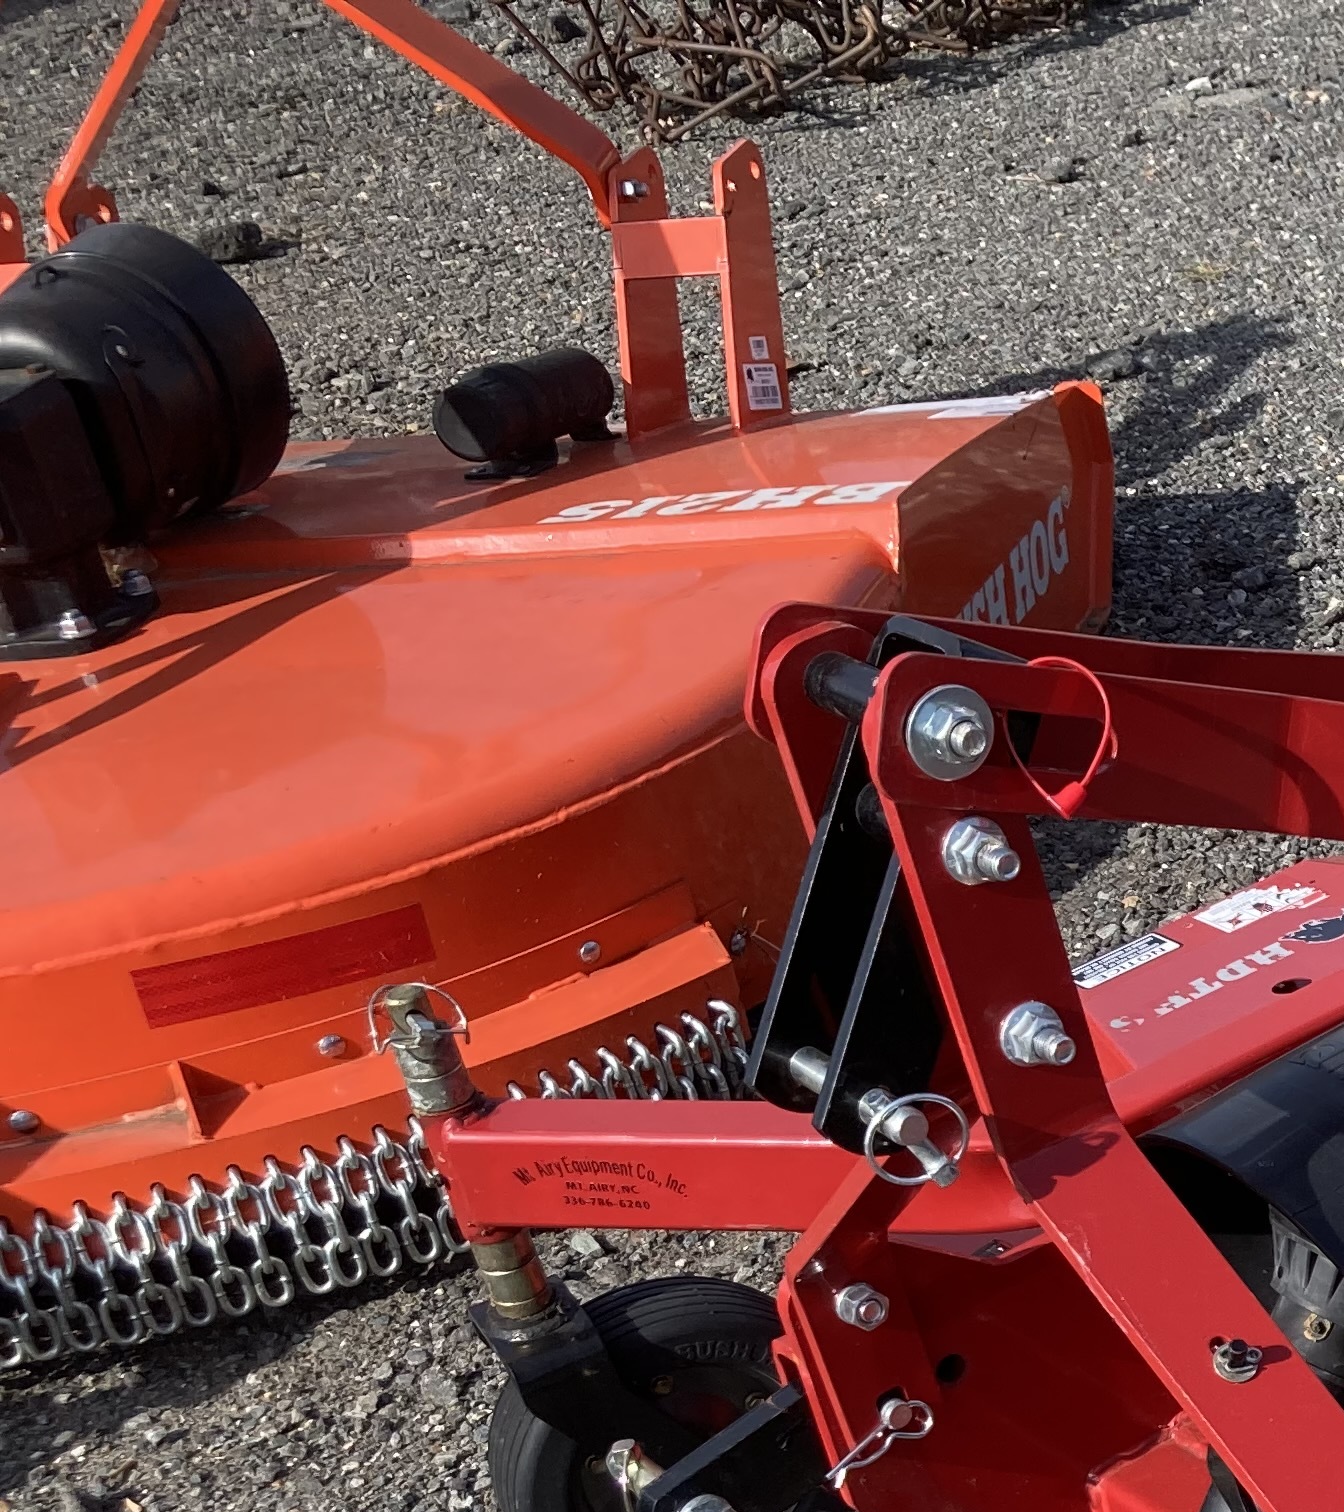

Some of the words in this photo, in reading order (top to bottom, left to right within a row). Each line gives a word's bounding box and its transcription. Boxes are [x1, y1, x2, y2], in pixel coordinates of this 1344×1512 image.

[537, 480, 912, 524] BH215
[1009, 495, 1069, 624] HOG
[534, 1158, 564, 1179] Airy
[560, 1155, 634, 1178] Equipment
[665, 1173, 689, 1198] Inc.
